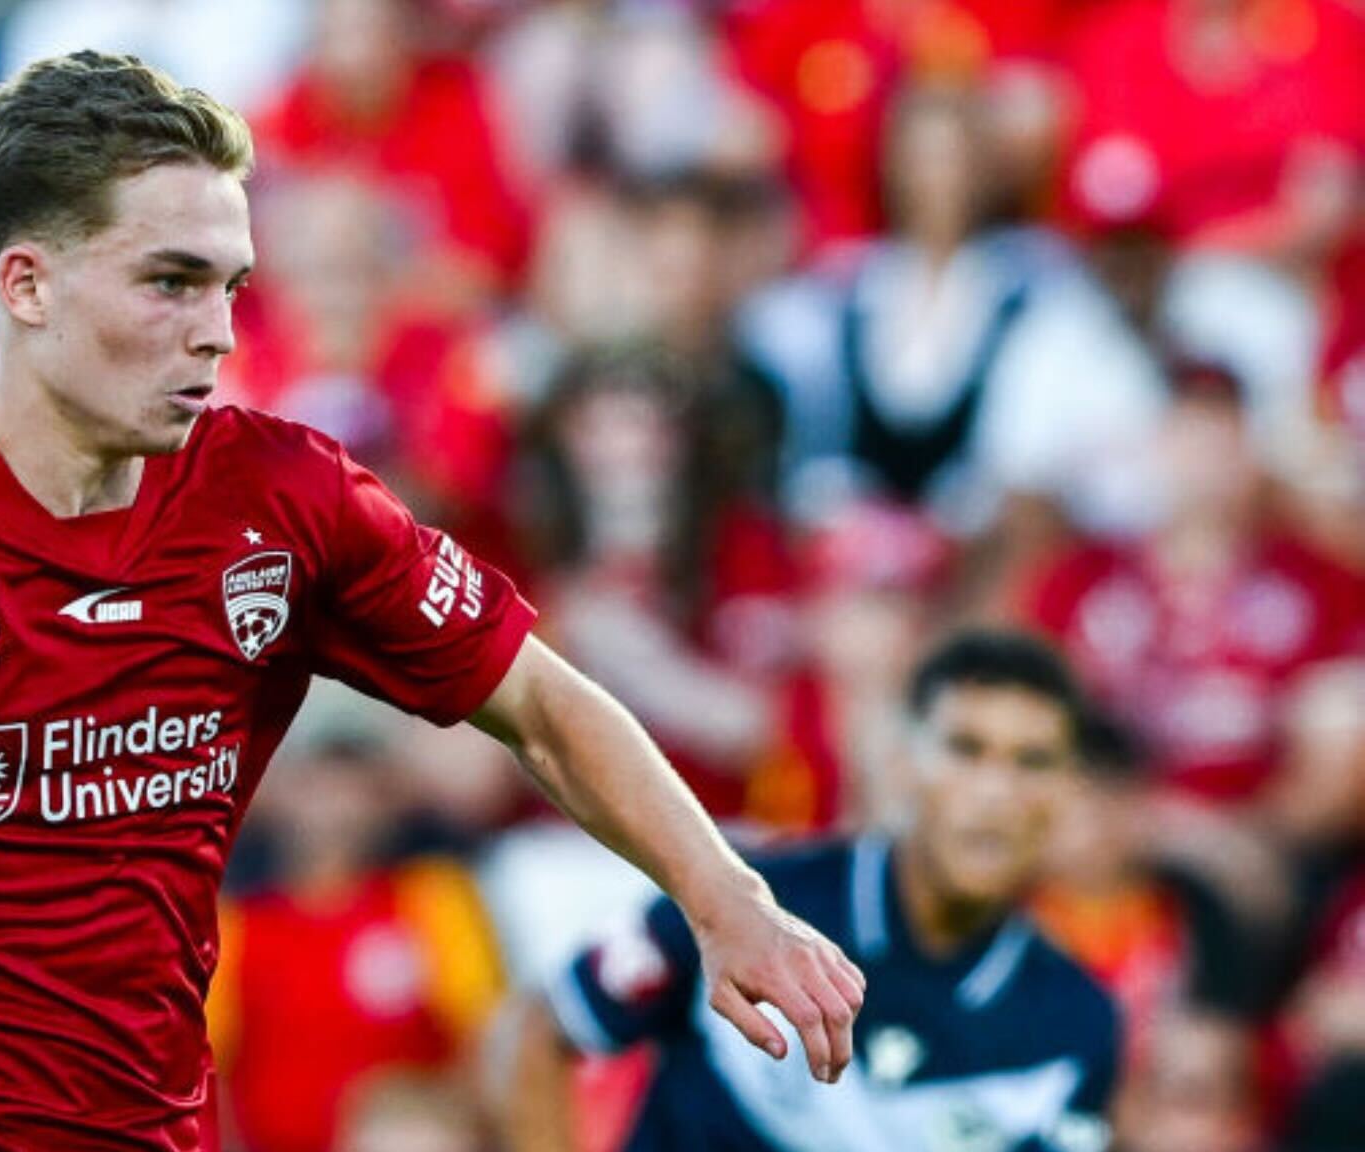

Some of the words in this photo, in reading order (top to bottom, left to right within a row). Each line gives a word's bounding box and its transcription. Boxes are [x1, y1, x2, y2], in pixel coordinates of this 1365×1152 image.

[419, 532, 464, 628] ISUZ
[460, 561, 484, 619] UTE
[43, 705, 221, 770] Flinders
[40, 742, 240, 822] University
